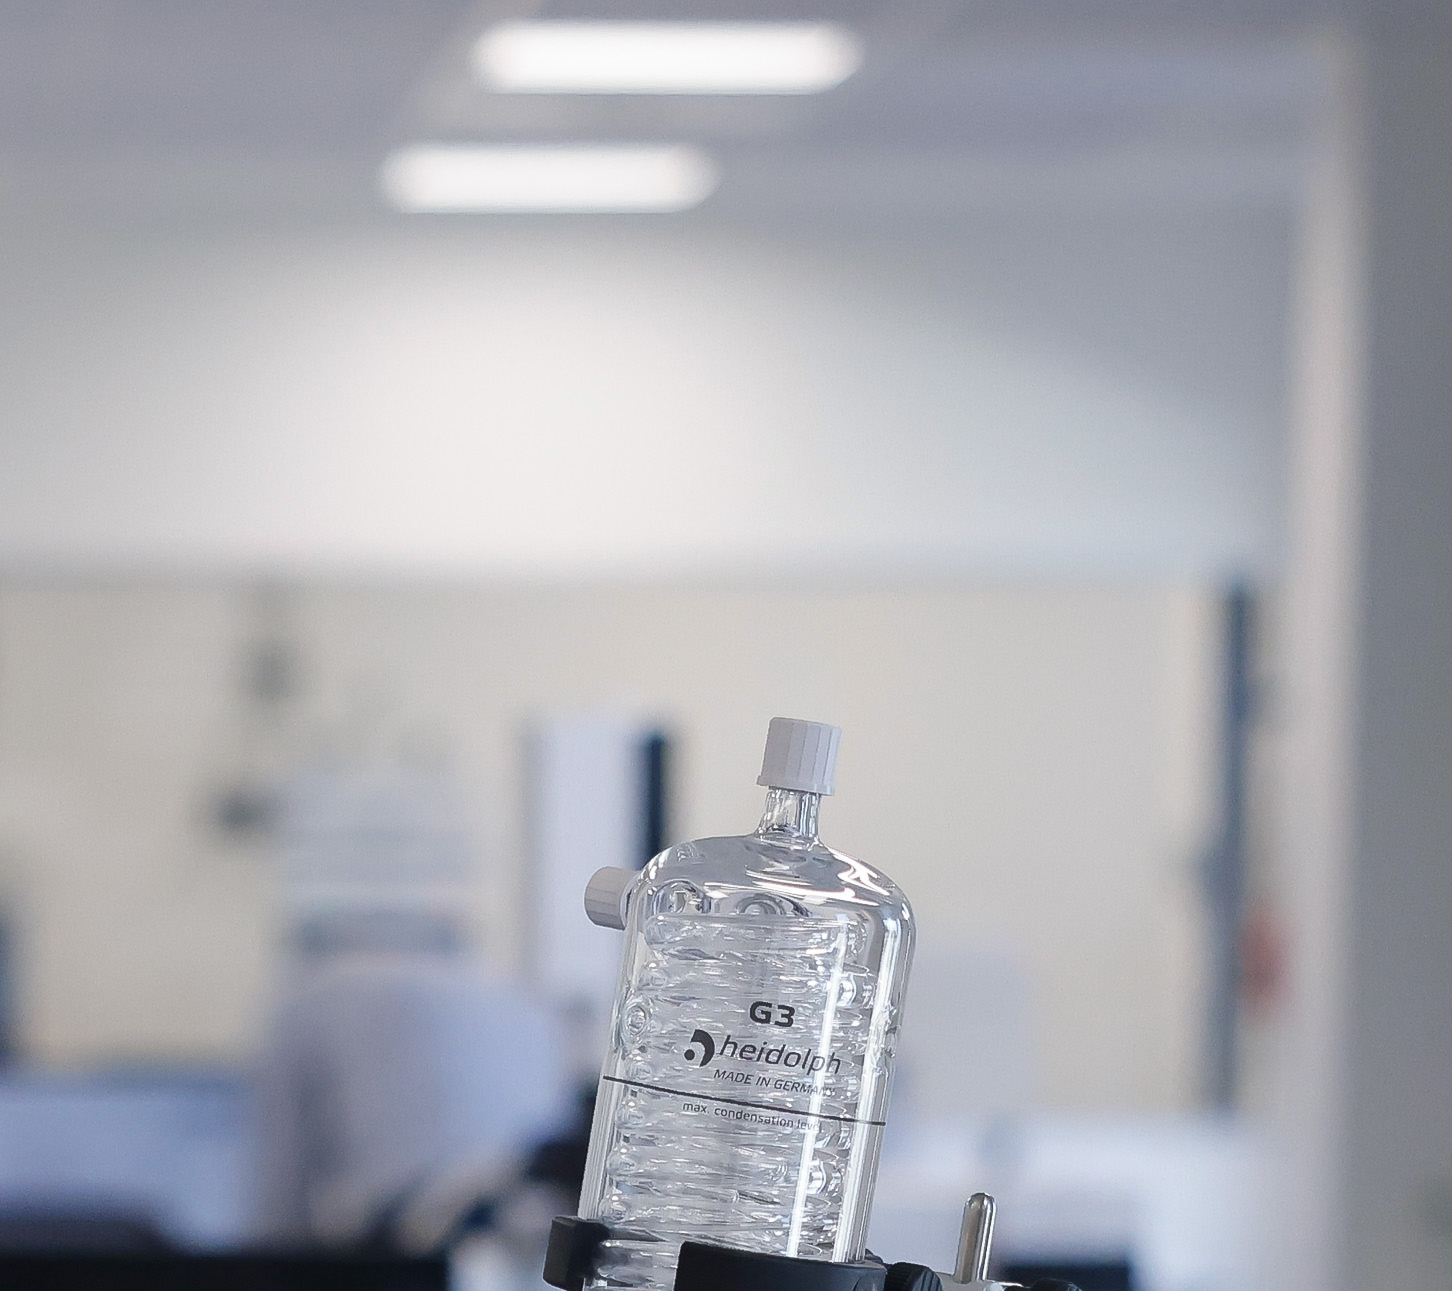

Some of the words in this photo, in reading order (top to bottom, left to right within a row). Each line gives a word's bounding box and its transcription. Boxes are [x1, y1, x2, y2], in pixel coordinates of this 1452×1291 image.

[749, 1000, 796, 1027] G3
[719, 1034, 841, 1075] heidolph
[713, 1069, 754, 1084] MADE
[756, 1076, 771, 1087] IN
[682, 1102, 709, 1114] max.
[714, 1106, 794, 1127] condensation
